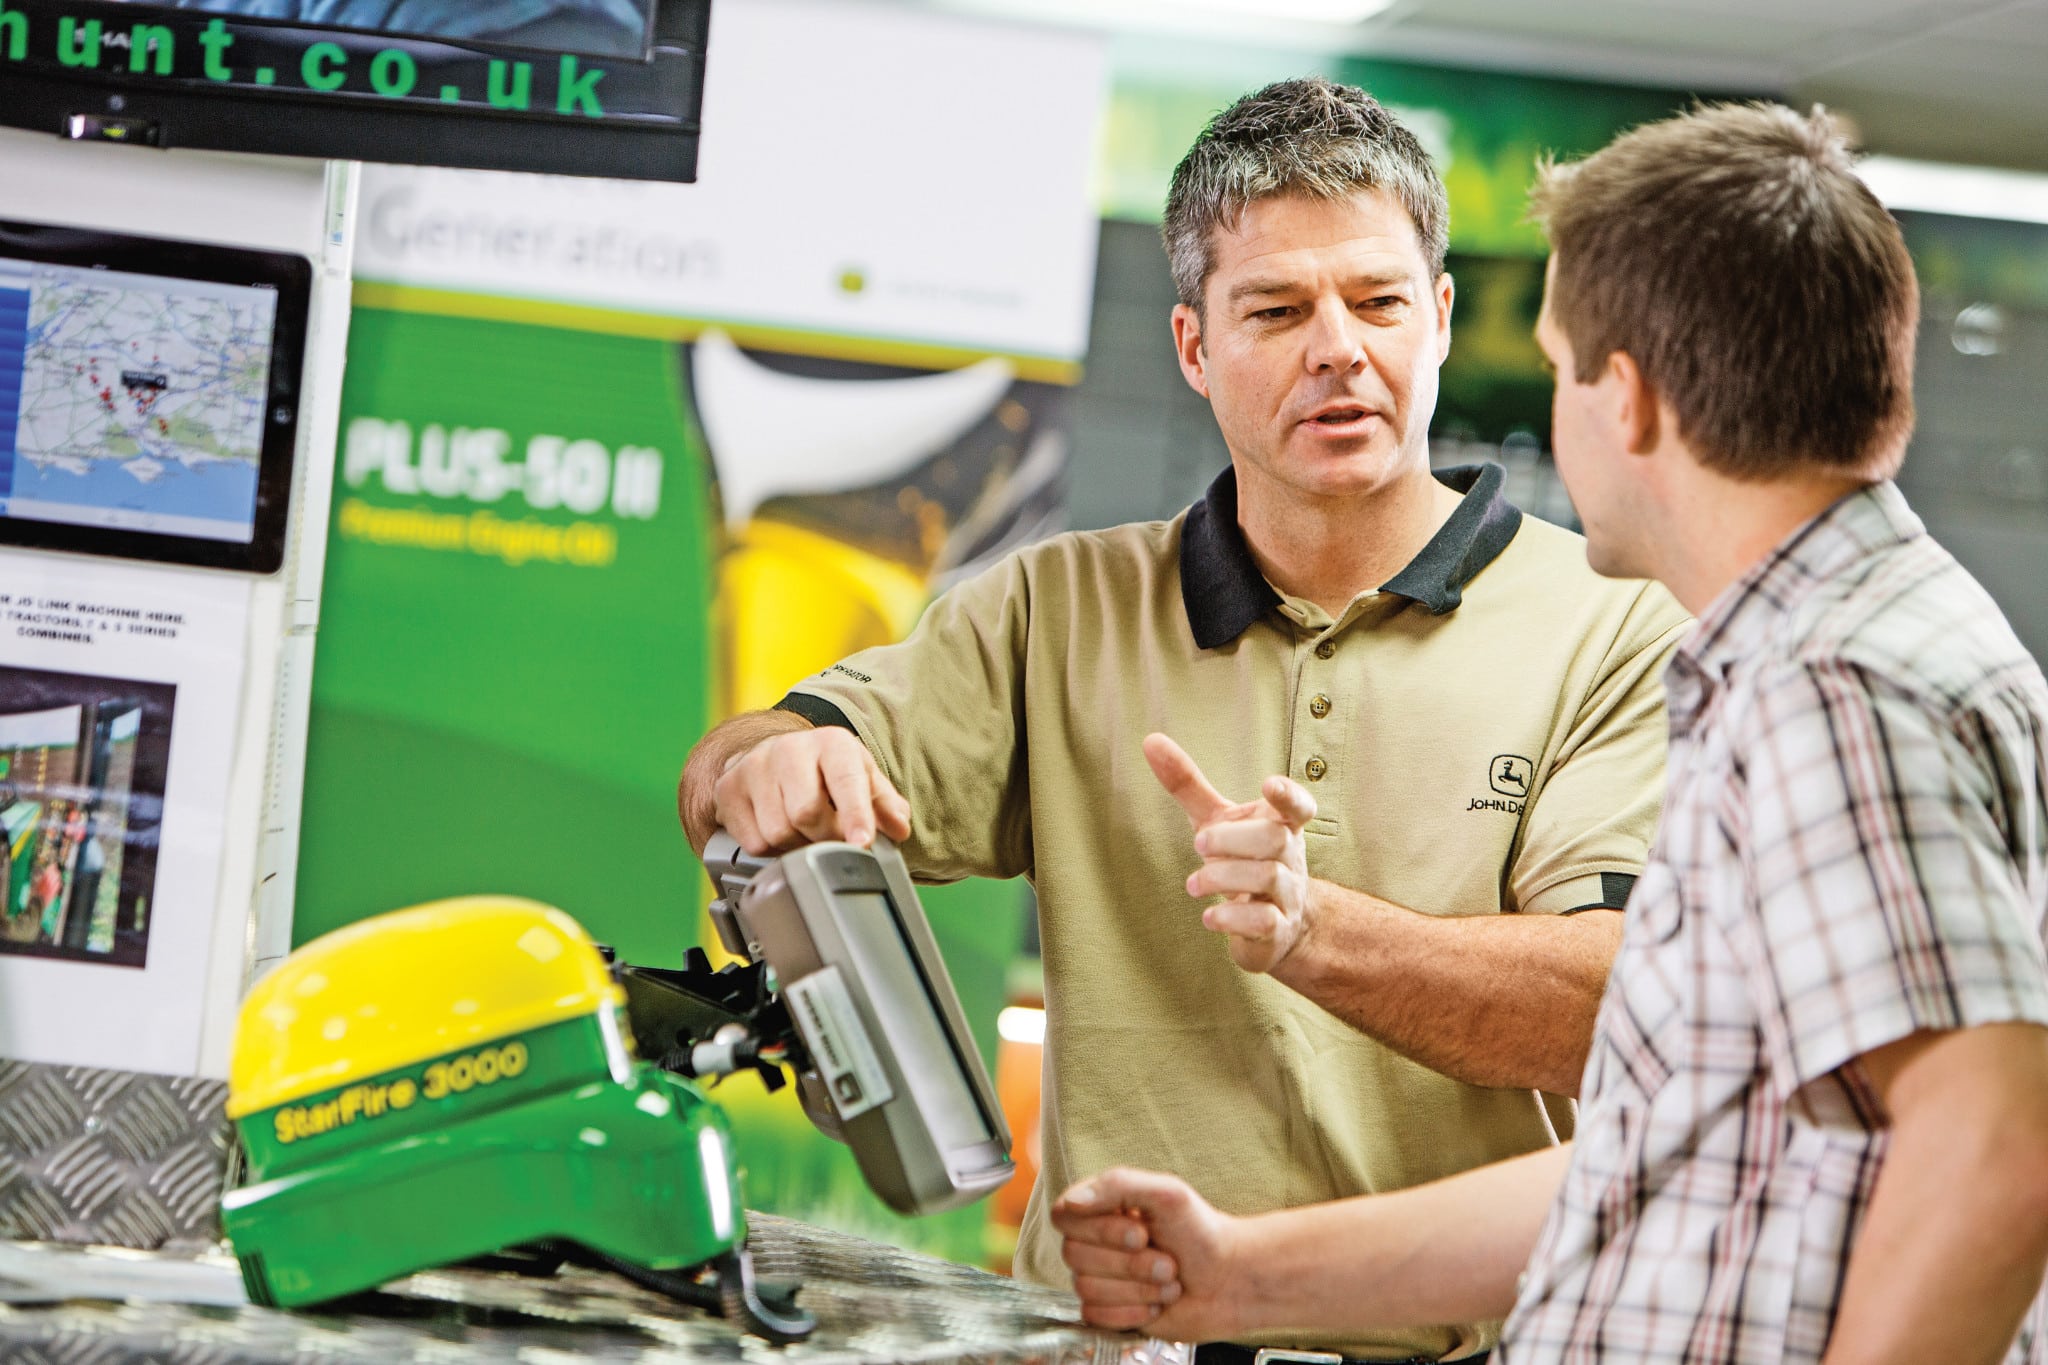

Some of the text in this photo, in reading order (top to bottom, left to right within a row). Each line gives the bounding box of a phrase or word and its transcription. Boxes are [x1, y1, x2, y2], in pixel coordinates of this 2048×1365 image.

[367, 184, 722, 281] Generation
[344, 415, 610, 515] PLUS-50
[38, 599, 70, 611] LINK
[76, 603, 140, 620] MACHINE
[1467, 798, 1506, 813] JOHN
[274, 1041, 528, 1144] StarFire 3000
